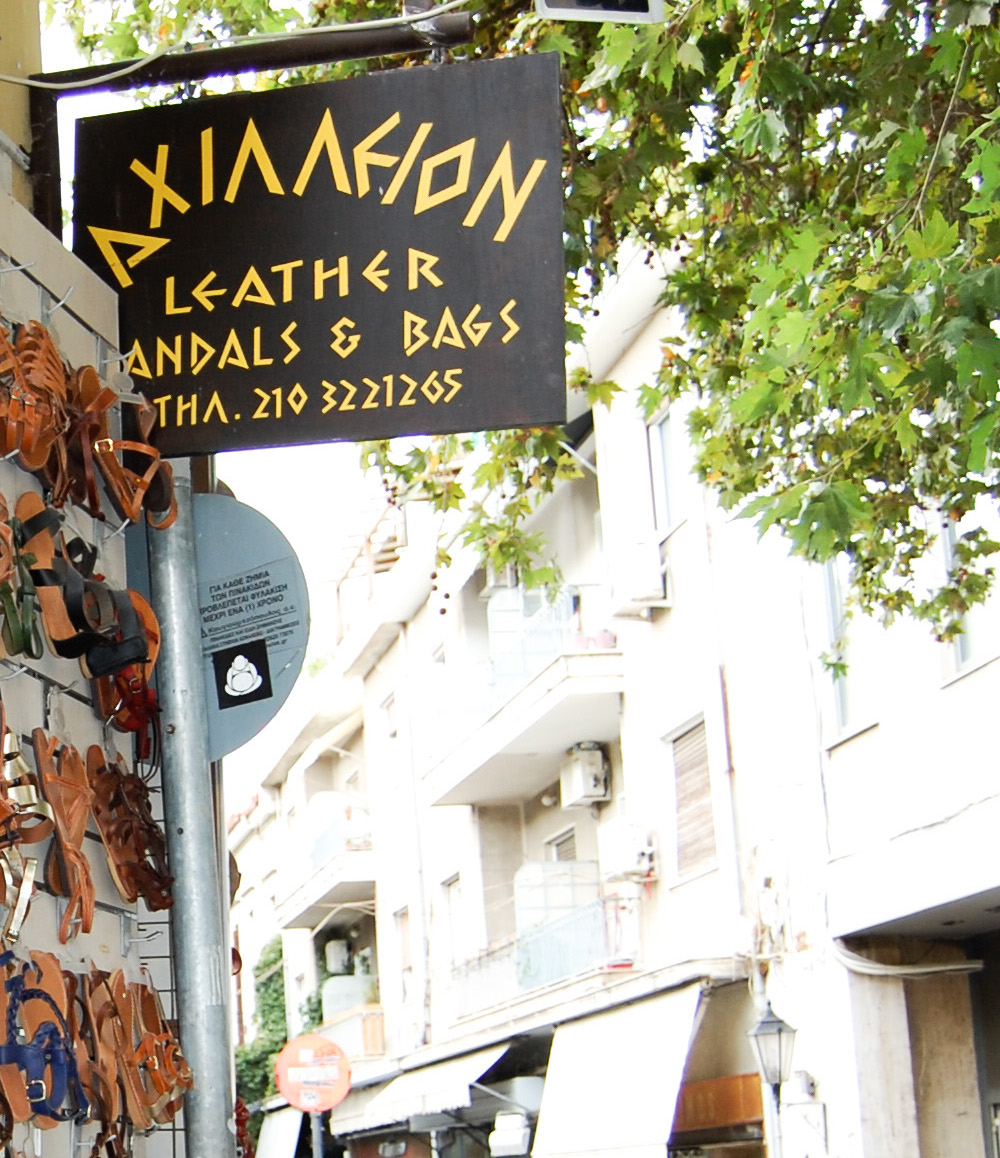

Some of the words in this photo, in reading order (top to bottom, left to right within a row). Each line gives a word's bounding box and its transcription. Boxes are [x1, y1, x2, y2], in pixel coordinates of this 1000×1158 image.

[165, 247, 443, 316] LEATHER
[126, 321, 301, 380] ANDALS
[330, 317, 361, 359] &
[403, 299, 521, 357] BAGS
[252, 381, 309, 419] 210
[321, 369, 463, 415] 3221265
[223, 577, 243, 588] ΚΑΘΕ
